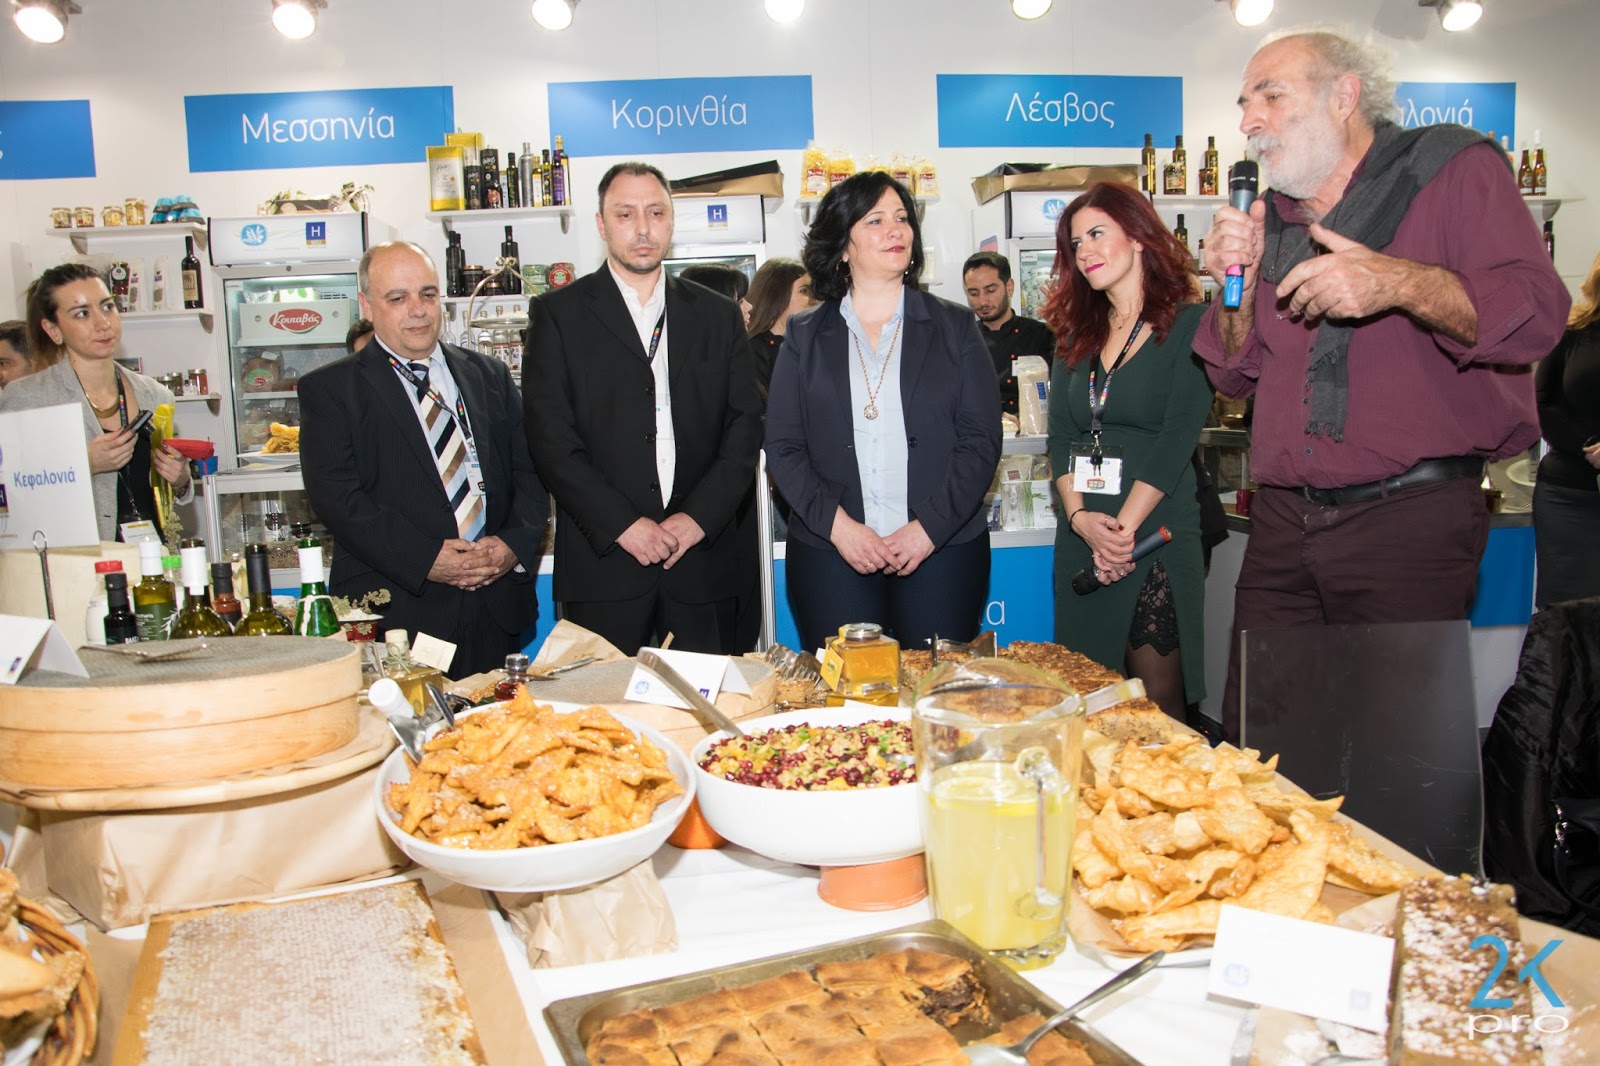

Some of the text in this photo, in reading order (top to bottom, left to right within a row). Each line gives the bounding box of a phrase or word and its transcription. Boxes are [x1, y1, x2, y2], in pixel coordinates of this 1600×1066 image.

[241, 107, 395, 145] Μεσσηνία
[611, 94, 747, 135] Κορινθία
[1005, 91, 1115, 129] Λέσβος
[272, 311, 320, 328] Κουταβάς
[13, 466, 76, 490] Κεφαλονιά
